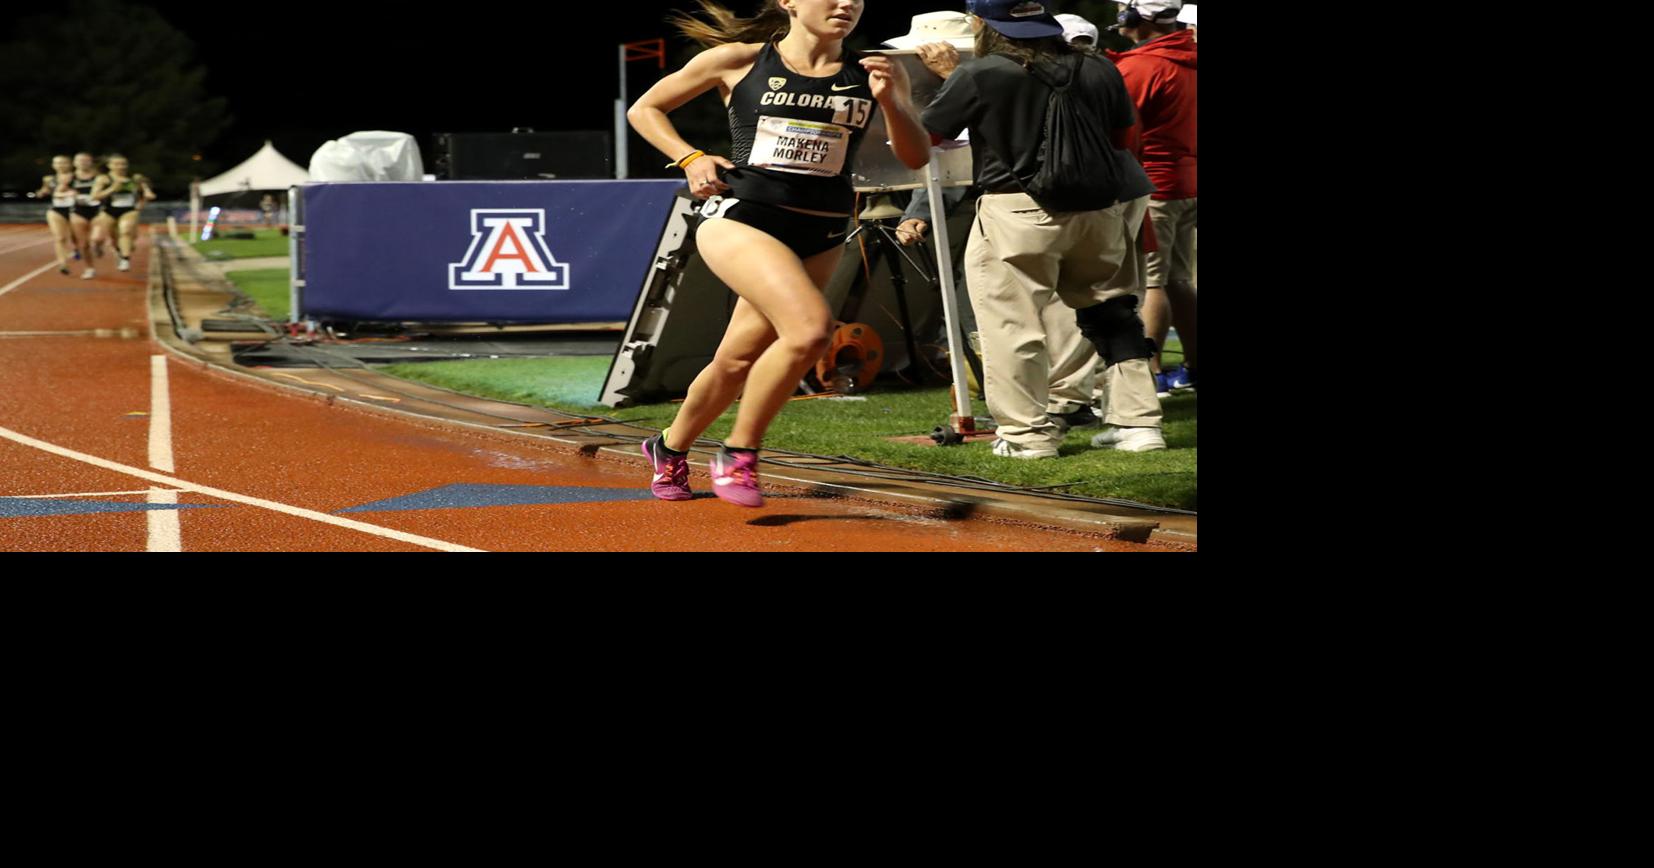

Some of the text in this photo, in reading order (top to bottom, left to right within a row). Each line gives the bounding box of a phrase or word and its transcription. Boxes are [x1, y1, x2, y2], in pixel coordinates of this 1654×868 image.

[843, 99, 868, 125] 15
[776, 135, 829, 153] MAKENA
[772, 147, 828, 164] MORLEY
[448, 208, 570, 290] A
